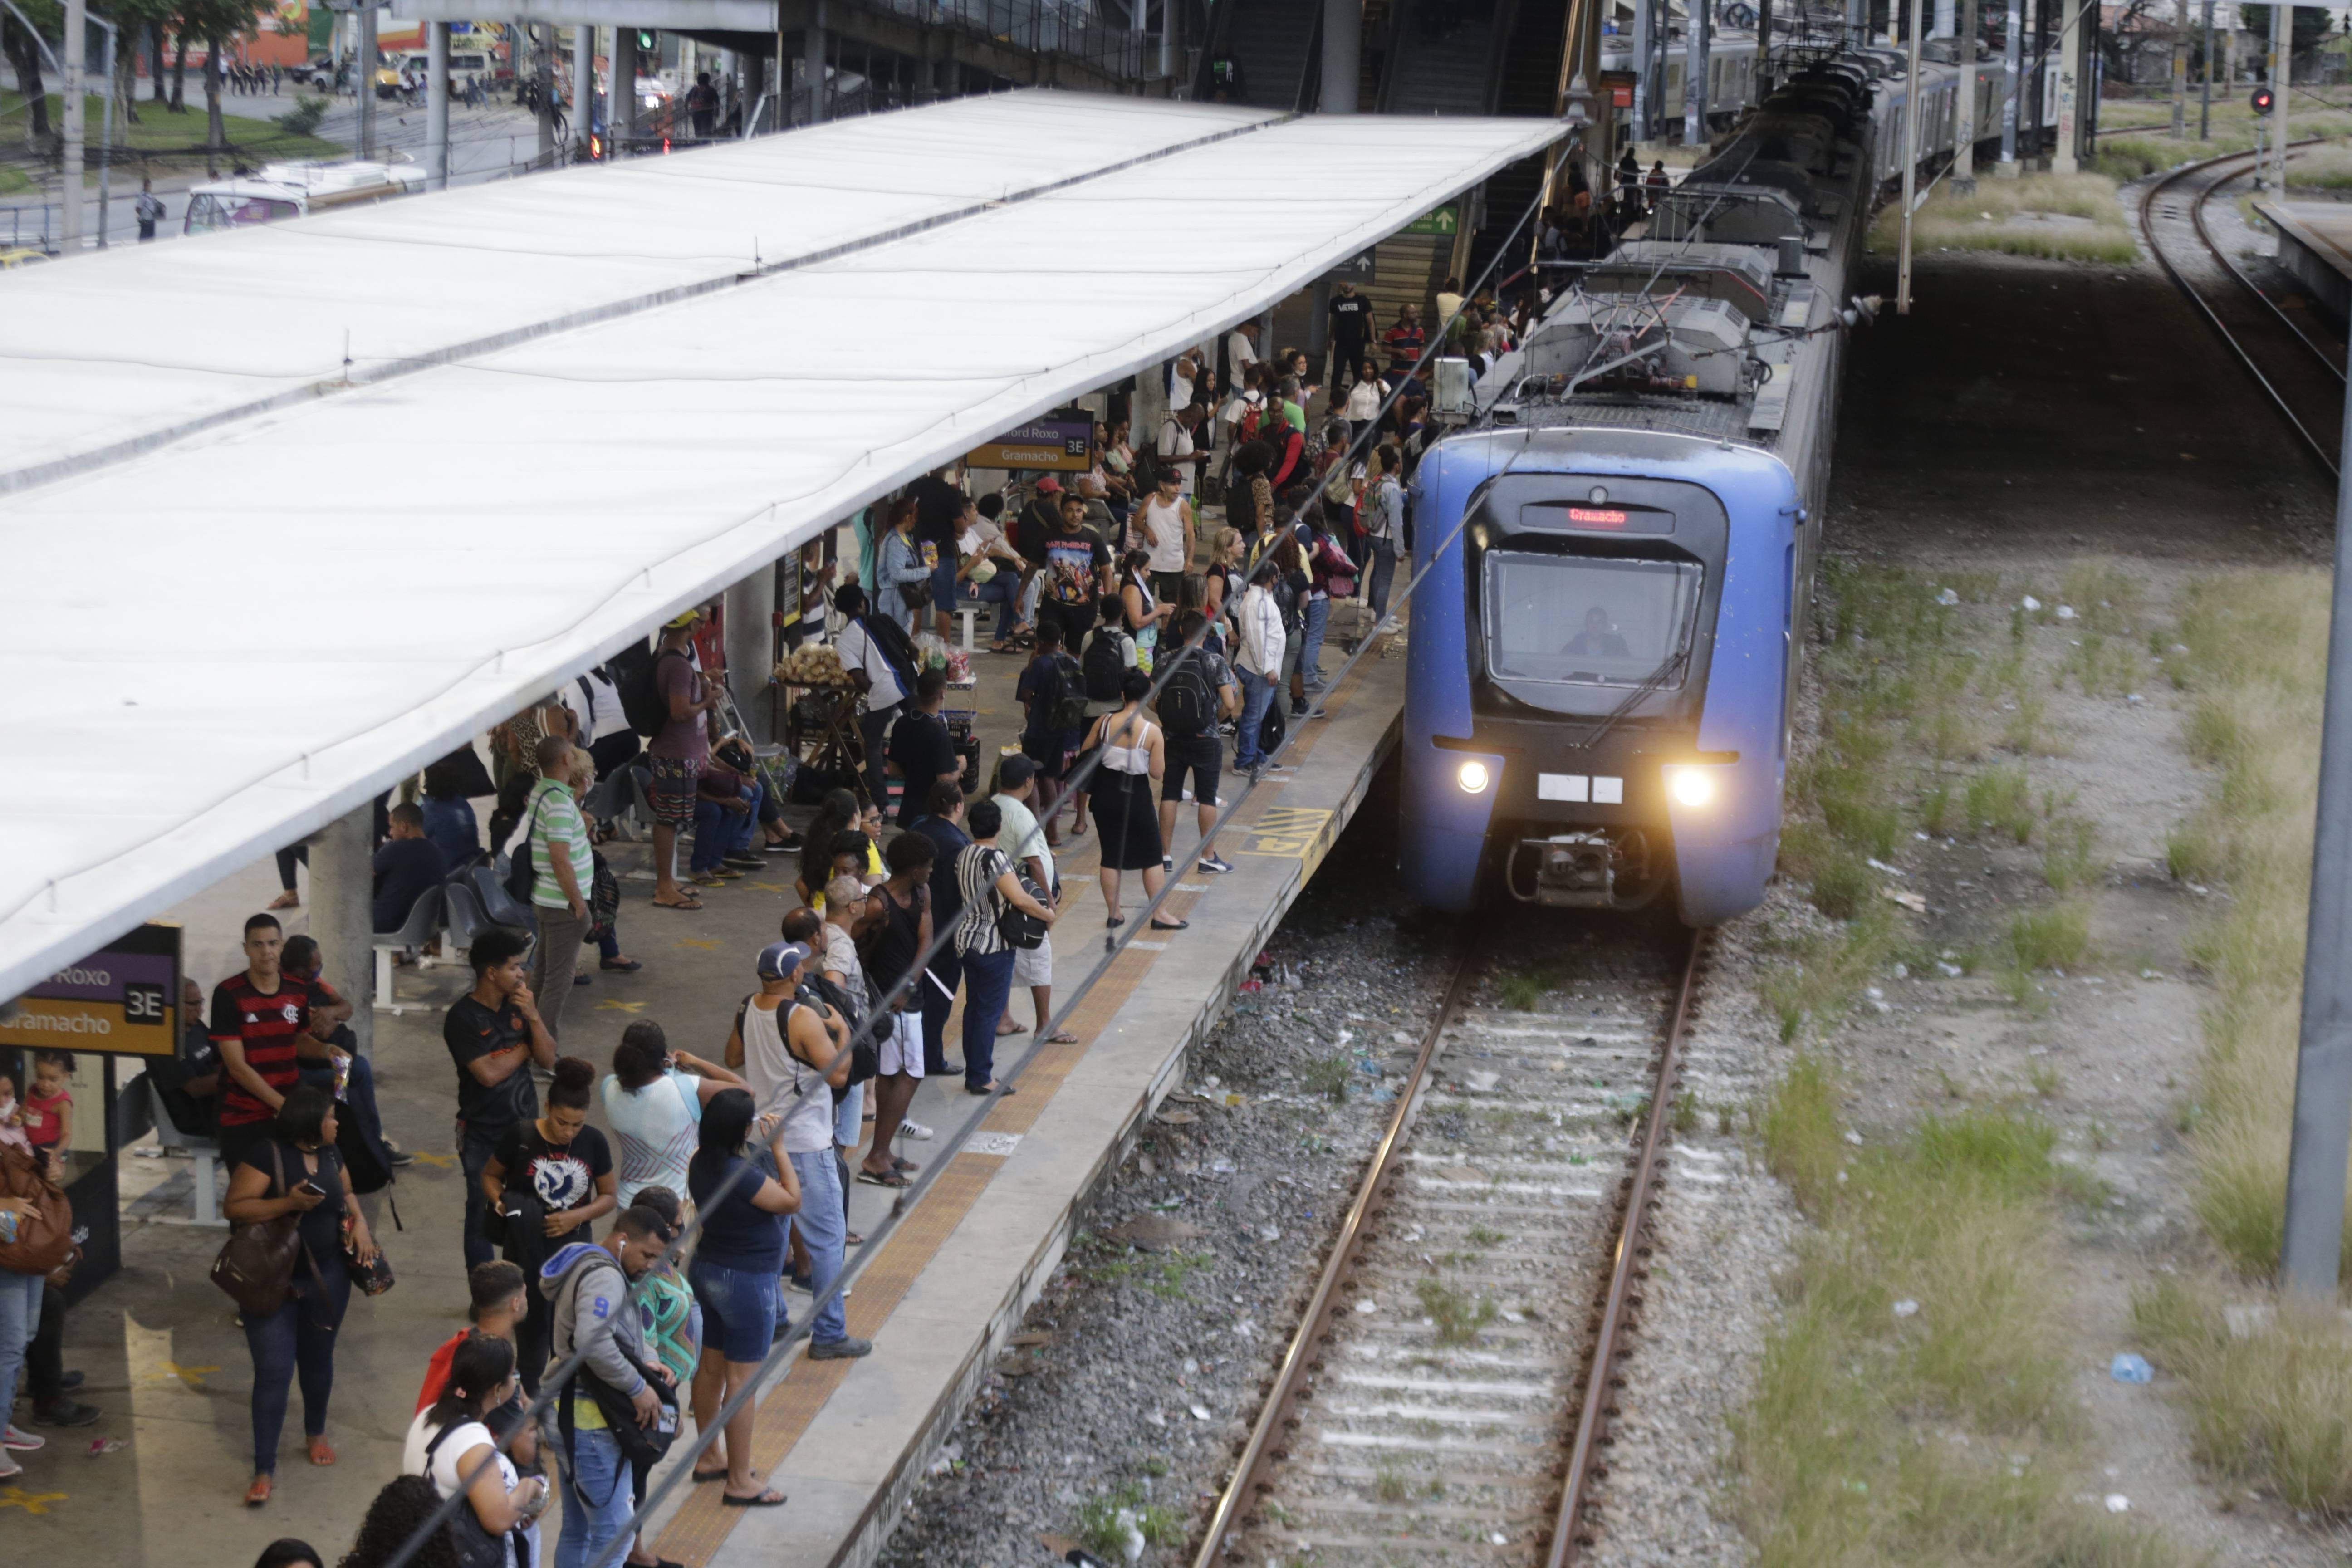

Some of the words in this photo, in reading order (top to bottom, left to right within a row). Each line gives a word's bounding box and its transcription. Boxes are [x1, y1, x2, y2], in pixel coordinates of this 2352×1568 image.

[1338, 304, 1359, 312] VANS
[1032, 428, 1059, 439] Roxo
[1067, 440, 1084, 454] 3E
[1002, 449, 1058, 462] Gramacho
[1569, 508, 1626, 523] Gramacho
[1061, 541, 1091, 552] MAIDEN
[56, 967, 111, 986] Roxo
[127, 990, 162, 1017] 3E
[593, 1296, 610, 1318] 9
